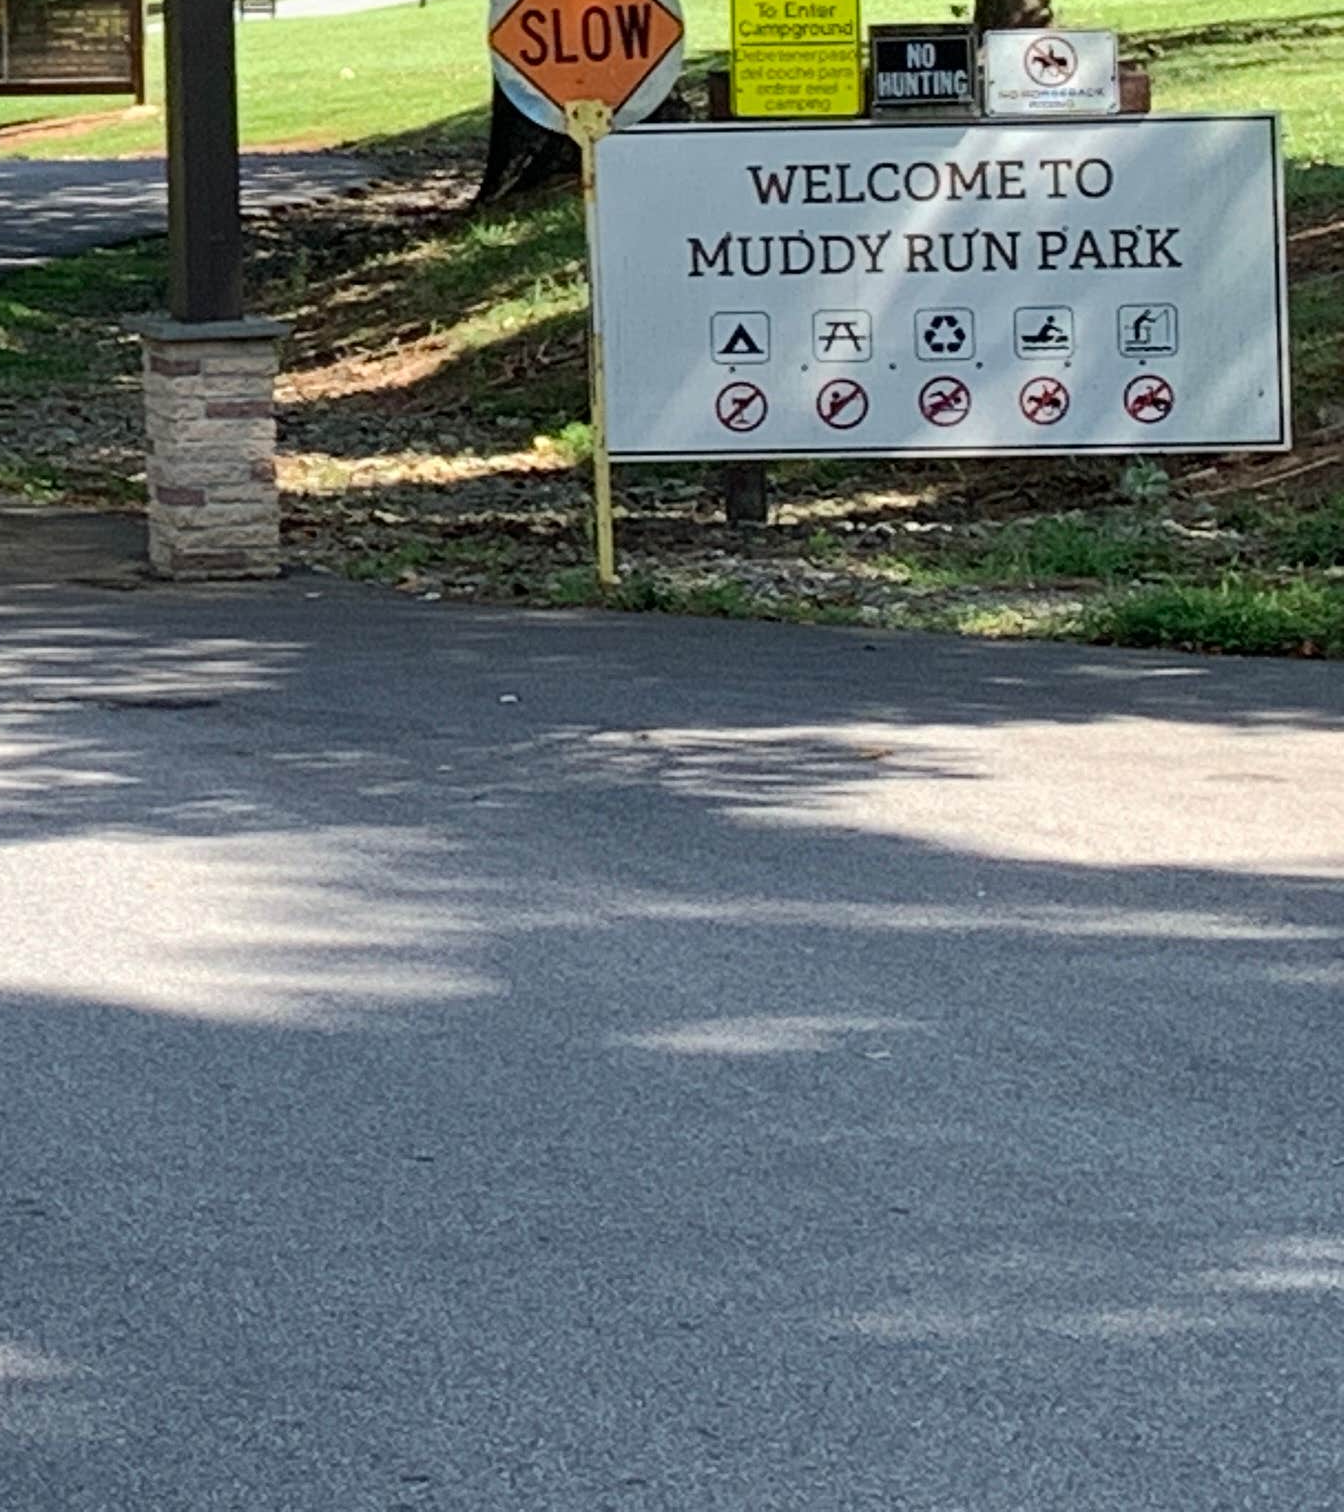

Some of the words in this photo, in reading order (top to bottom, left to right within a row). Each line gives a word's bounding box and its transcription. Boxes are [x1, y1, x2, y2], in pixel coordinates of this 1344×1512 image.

[754, 1, 777, 18] To
[785, 0, 837, 18] Enter
[520, 2, 652, 67] SLOW
[738, 19, 853, 38] Campground
[906, 43, 936, 68] NO
[878, 69, 968, 97] HUNTING
[746, 159, 1023, 206] WELCOME
[1039, 157, 1115, 199] TO
[687, 232, 889, 278] MUDDY
[903, 228, 1022, 273] RUN
[1036, 226, 1183, 271] PARK
